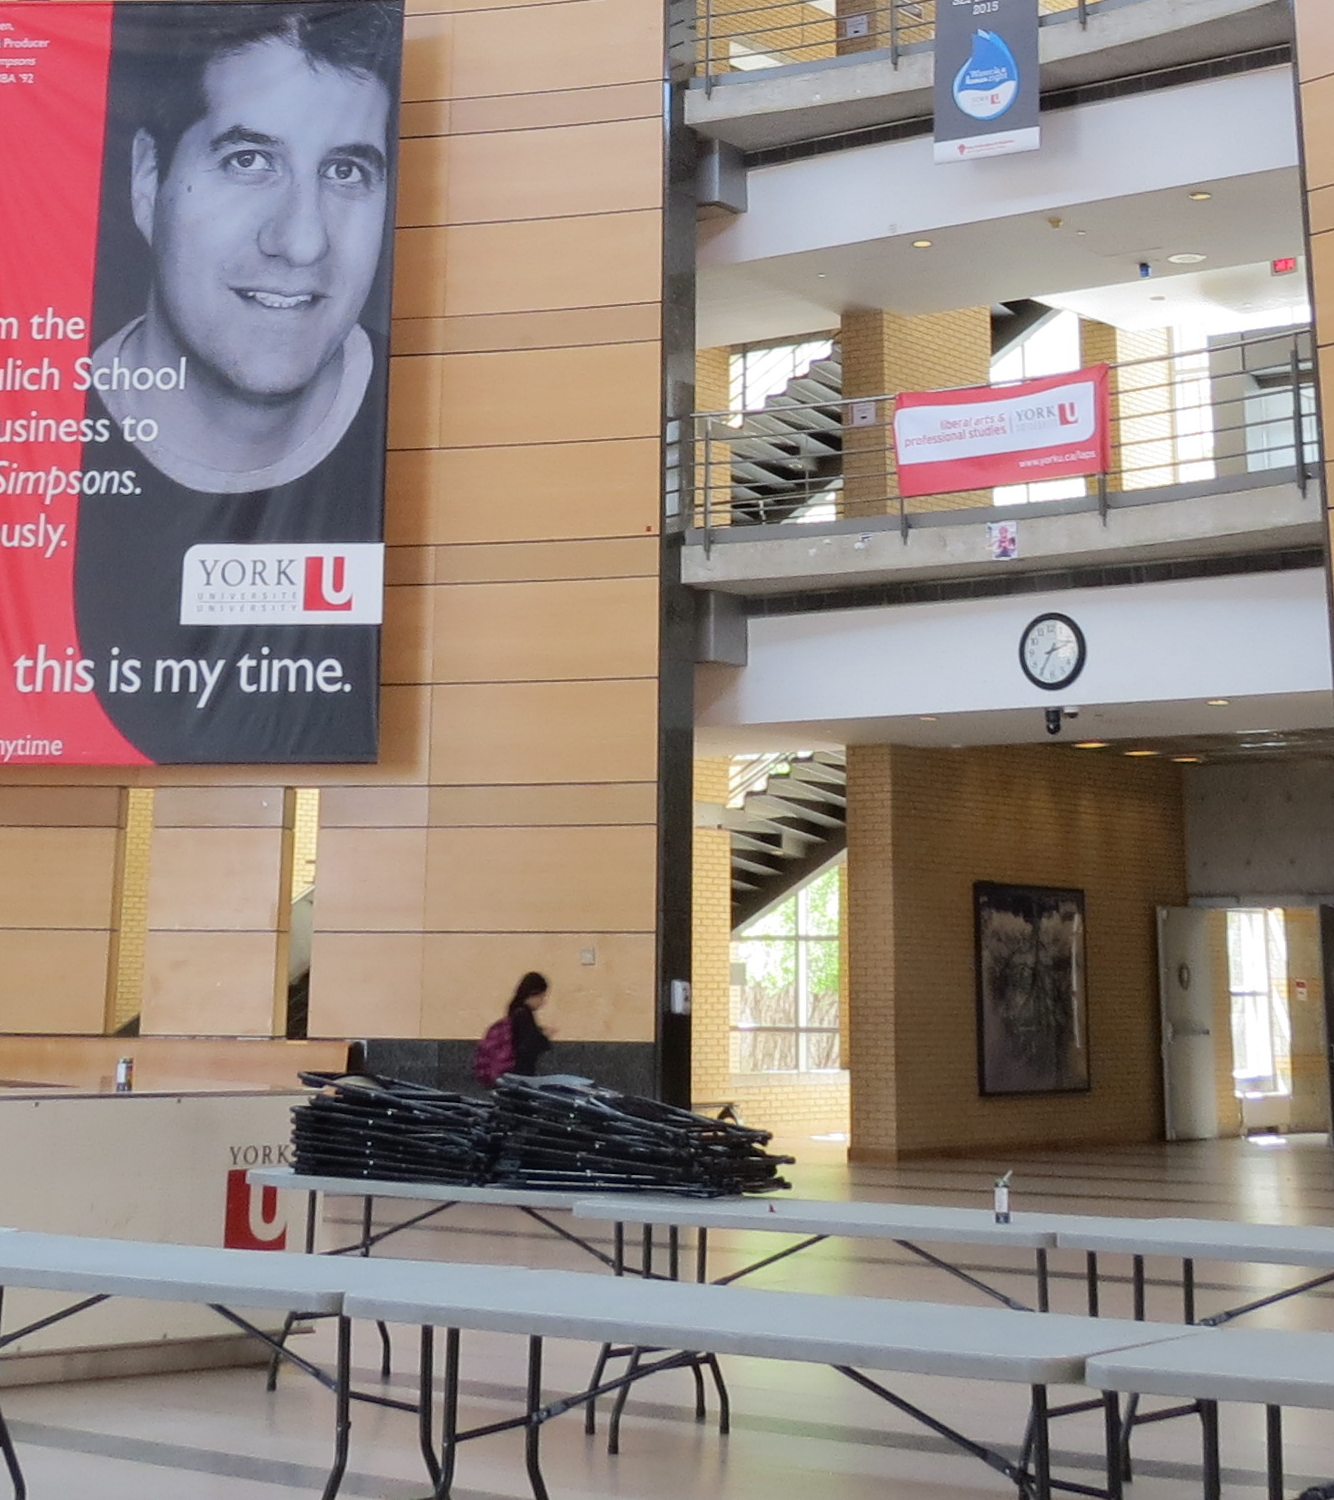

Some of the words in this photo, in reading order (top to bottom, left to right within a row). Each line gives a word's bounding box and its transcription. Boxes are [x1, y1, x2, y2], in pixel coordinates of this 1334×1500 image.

[973, 1, 999, 15] 2015
[3, 38, 50, 48] Producer
[29, 306, 86, 341] the
[73, 356, 188, 391] School
[121, 415, 160, 443] to
[940, 417, 972, 430] liberal
[974, 414, 995, 426] arts
[997, 412, 1006, 422] &
[1015, 405, 1056, 421] YORK
[905, 429, 966, 448] professional
[968, 424, 1007, 438] studies
[198, 559, 298, 587] YORK
[196, 604, 299, 612] UNIVERSITY
[13, 648, 95, 695] this
[107, 646, 143, 695] is
[153, 656, 222, 710] my
[236, 645, 353, 695] time.
[230, 1145, 292, 1165] YORK
